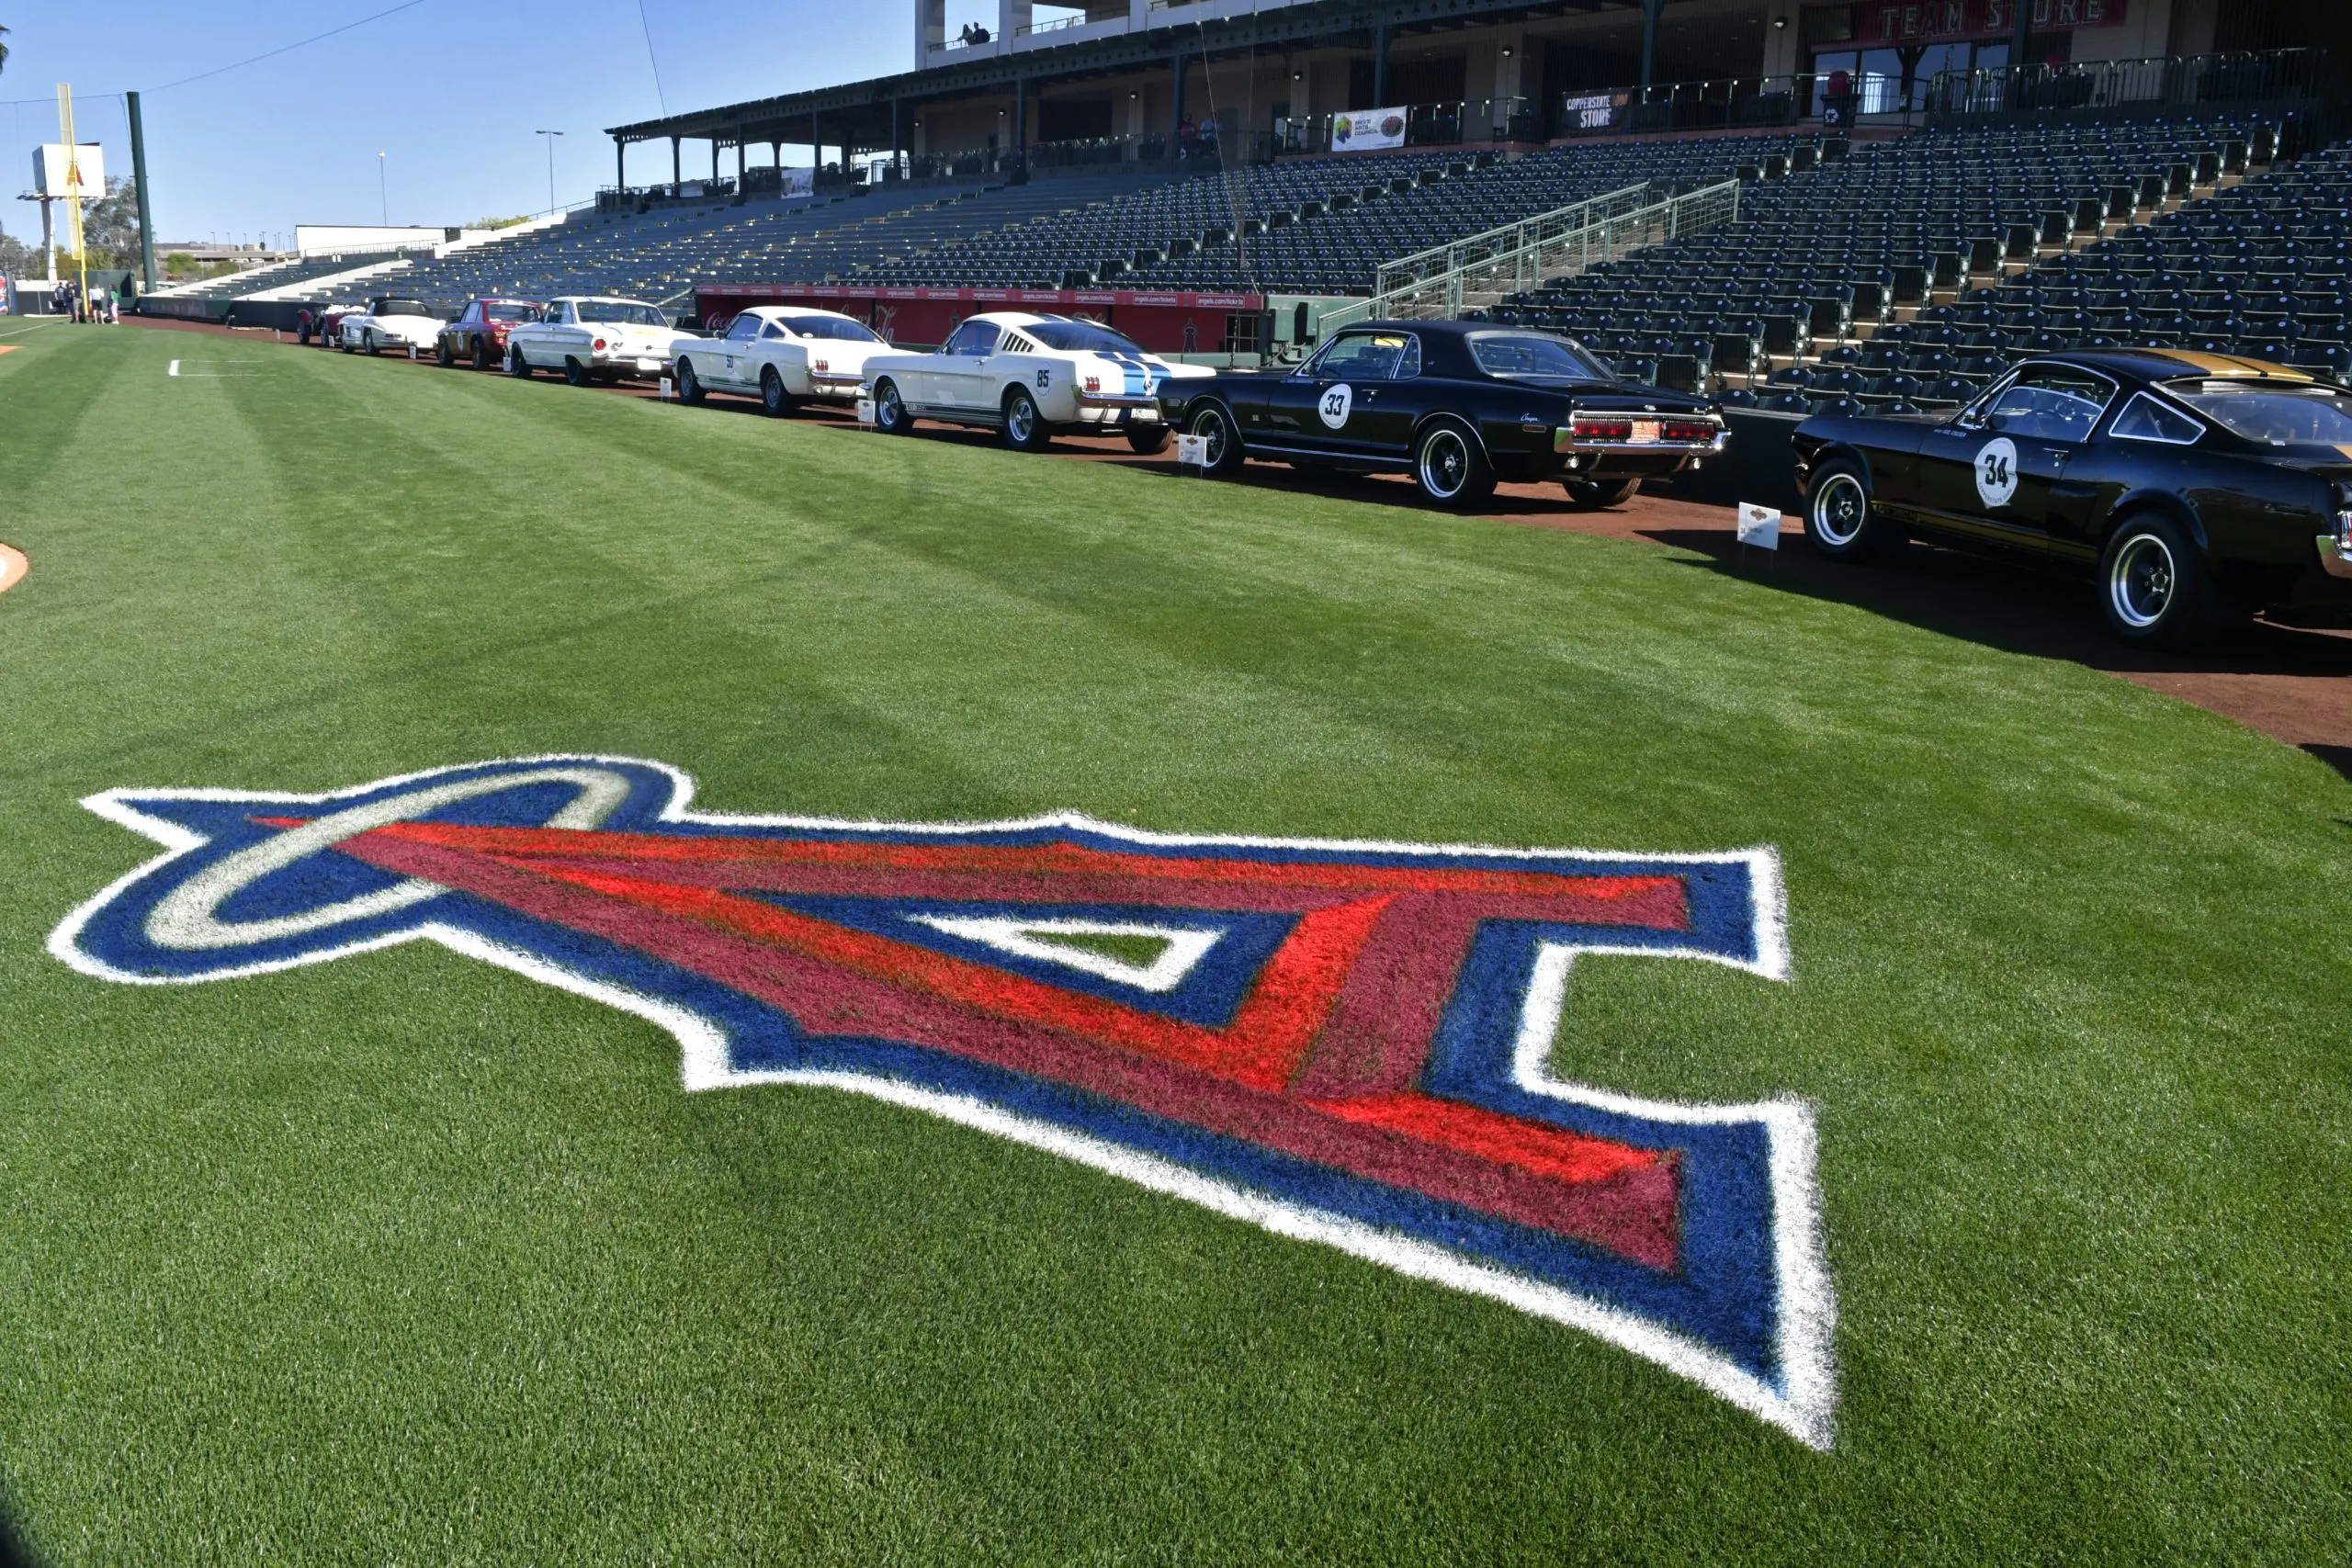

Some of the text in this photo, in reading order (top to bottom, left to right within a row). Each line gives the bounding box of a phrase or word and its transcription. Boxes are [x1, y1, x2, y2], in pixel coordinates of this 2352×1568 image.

[1881, 1, 1965, 39] TEAM
[1566, 96, 1611, 110] COPPERSTATE
[1580, 108, 1611, 128] STORE
[1134, 296, 1177, 304] angels.com/tickets
[1037, 369, 1049, 388] 85
[1325, 393, 1345, 416] 33
[1984, 454, 2008, 488] 34
